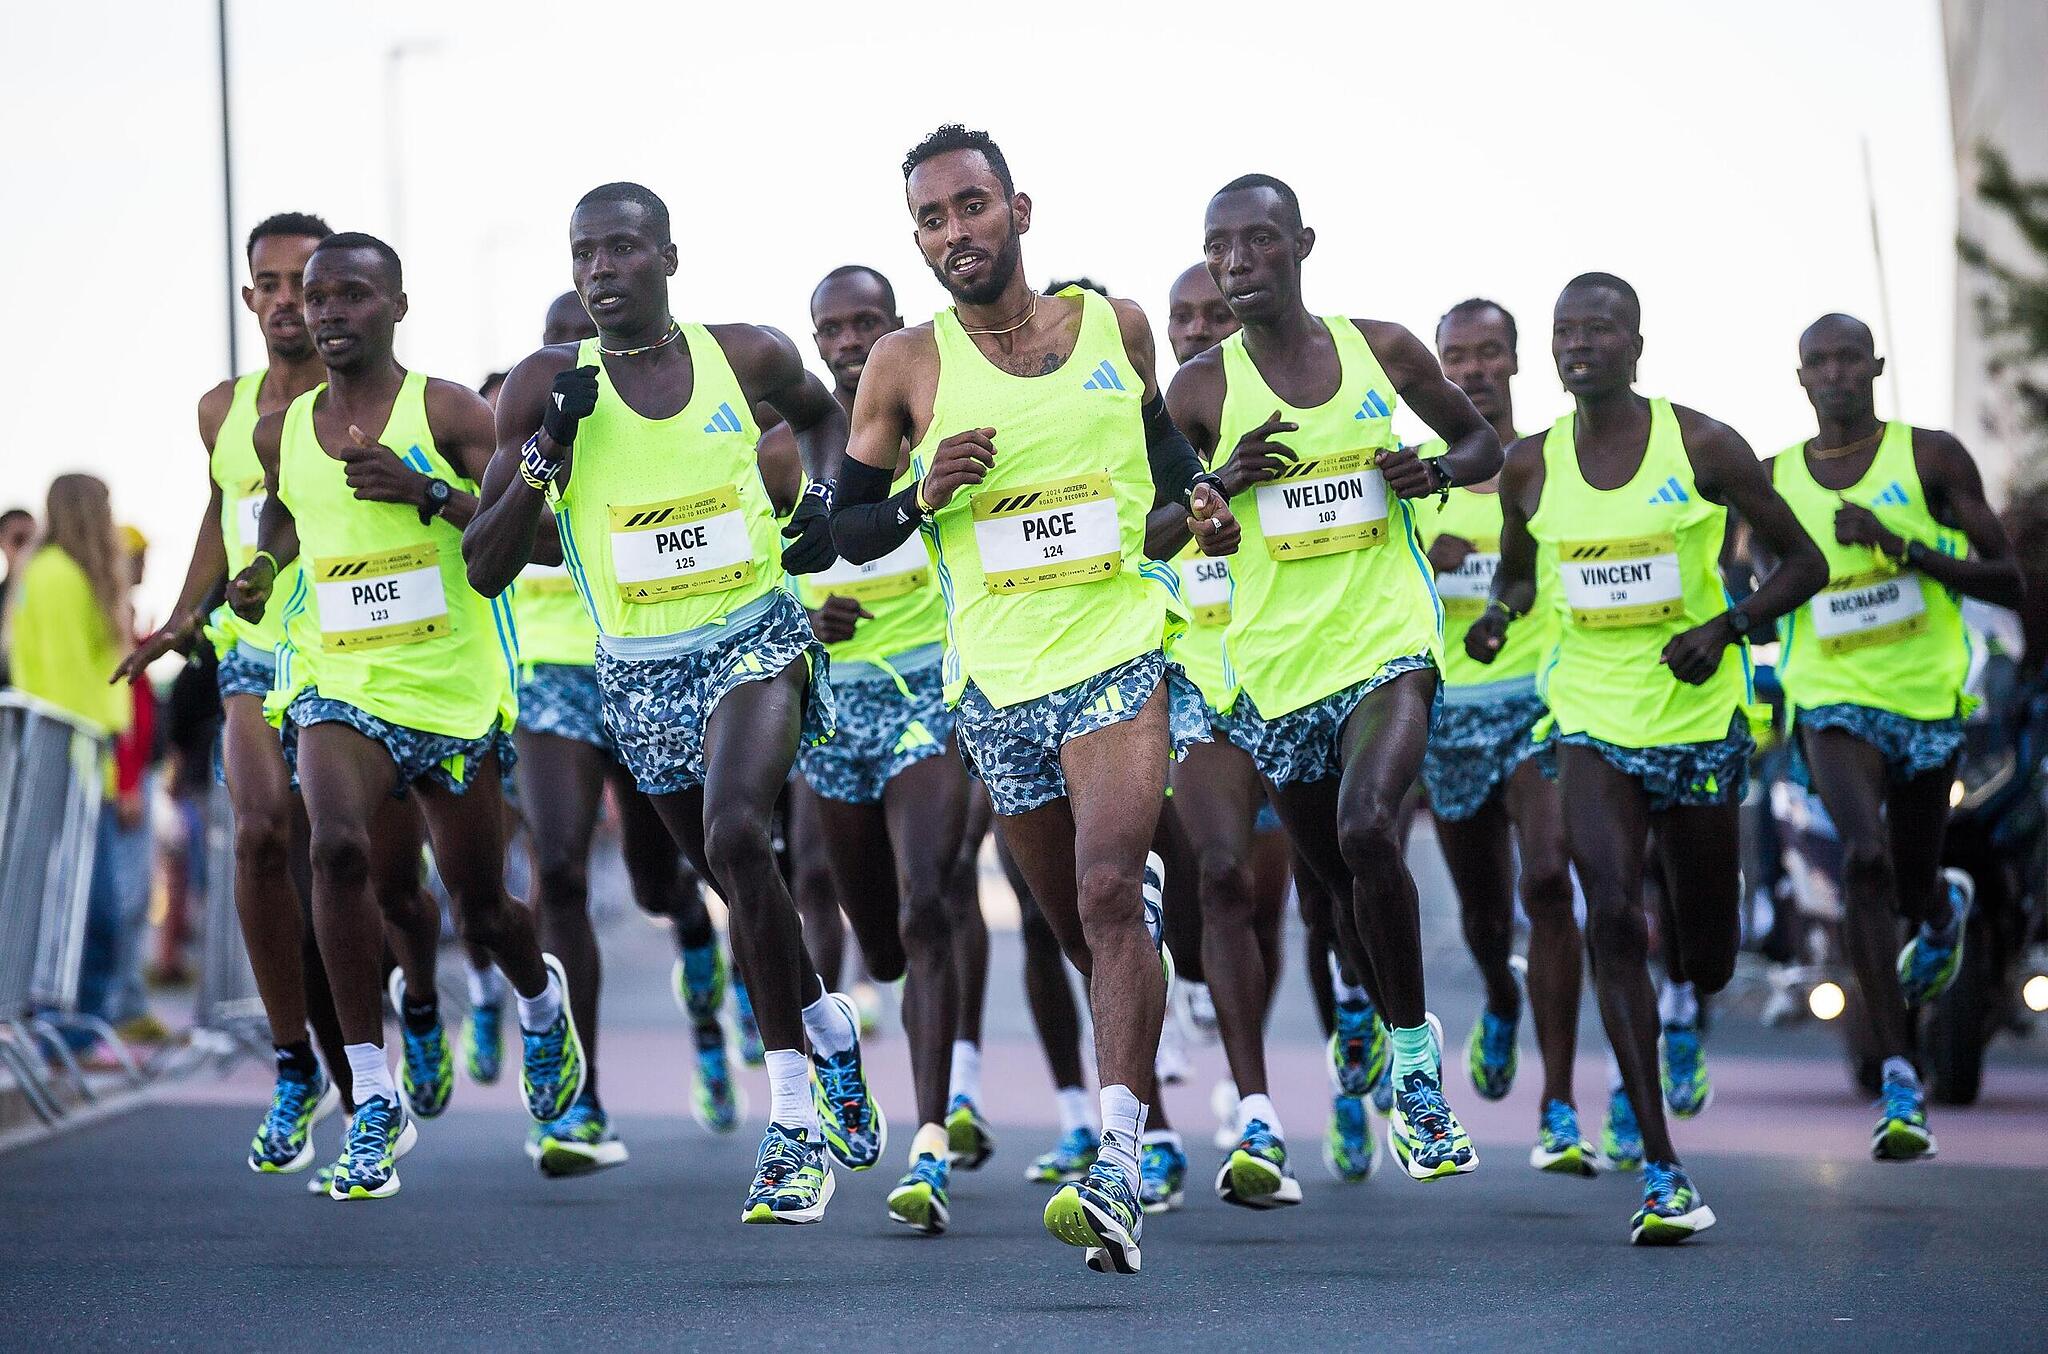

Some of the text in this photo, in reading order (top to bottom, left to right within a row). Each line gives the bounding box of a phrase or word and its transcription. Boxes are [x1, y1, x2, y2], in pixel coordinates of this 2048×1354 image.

[1046, 484, 1088, 497] 2024 ADIZERO
[1283, 478, 1364, 509] WELDON
[1039, 492, 1088, 506] ROAD TO RECORDS
[697, 505, 718, 515] RECORDS
[1318, 510, 1337, 523] 103
[1022, 512, 1077, 542] PACE
[655, 526, 708, 554] PACE
[1042, 545, 1064, 559] 124
[675, 556, 696, 570] 125
[1196, 561, 1228, 582] SAB
[1581, 562, 1652, 585] VINCENT
[352, 580, 401, 605] PACE
[370, 609, 390, 621] 123
